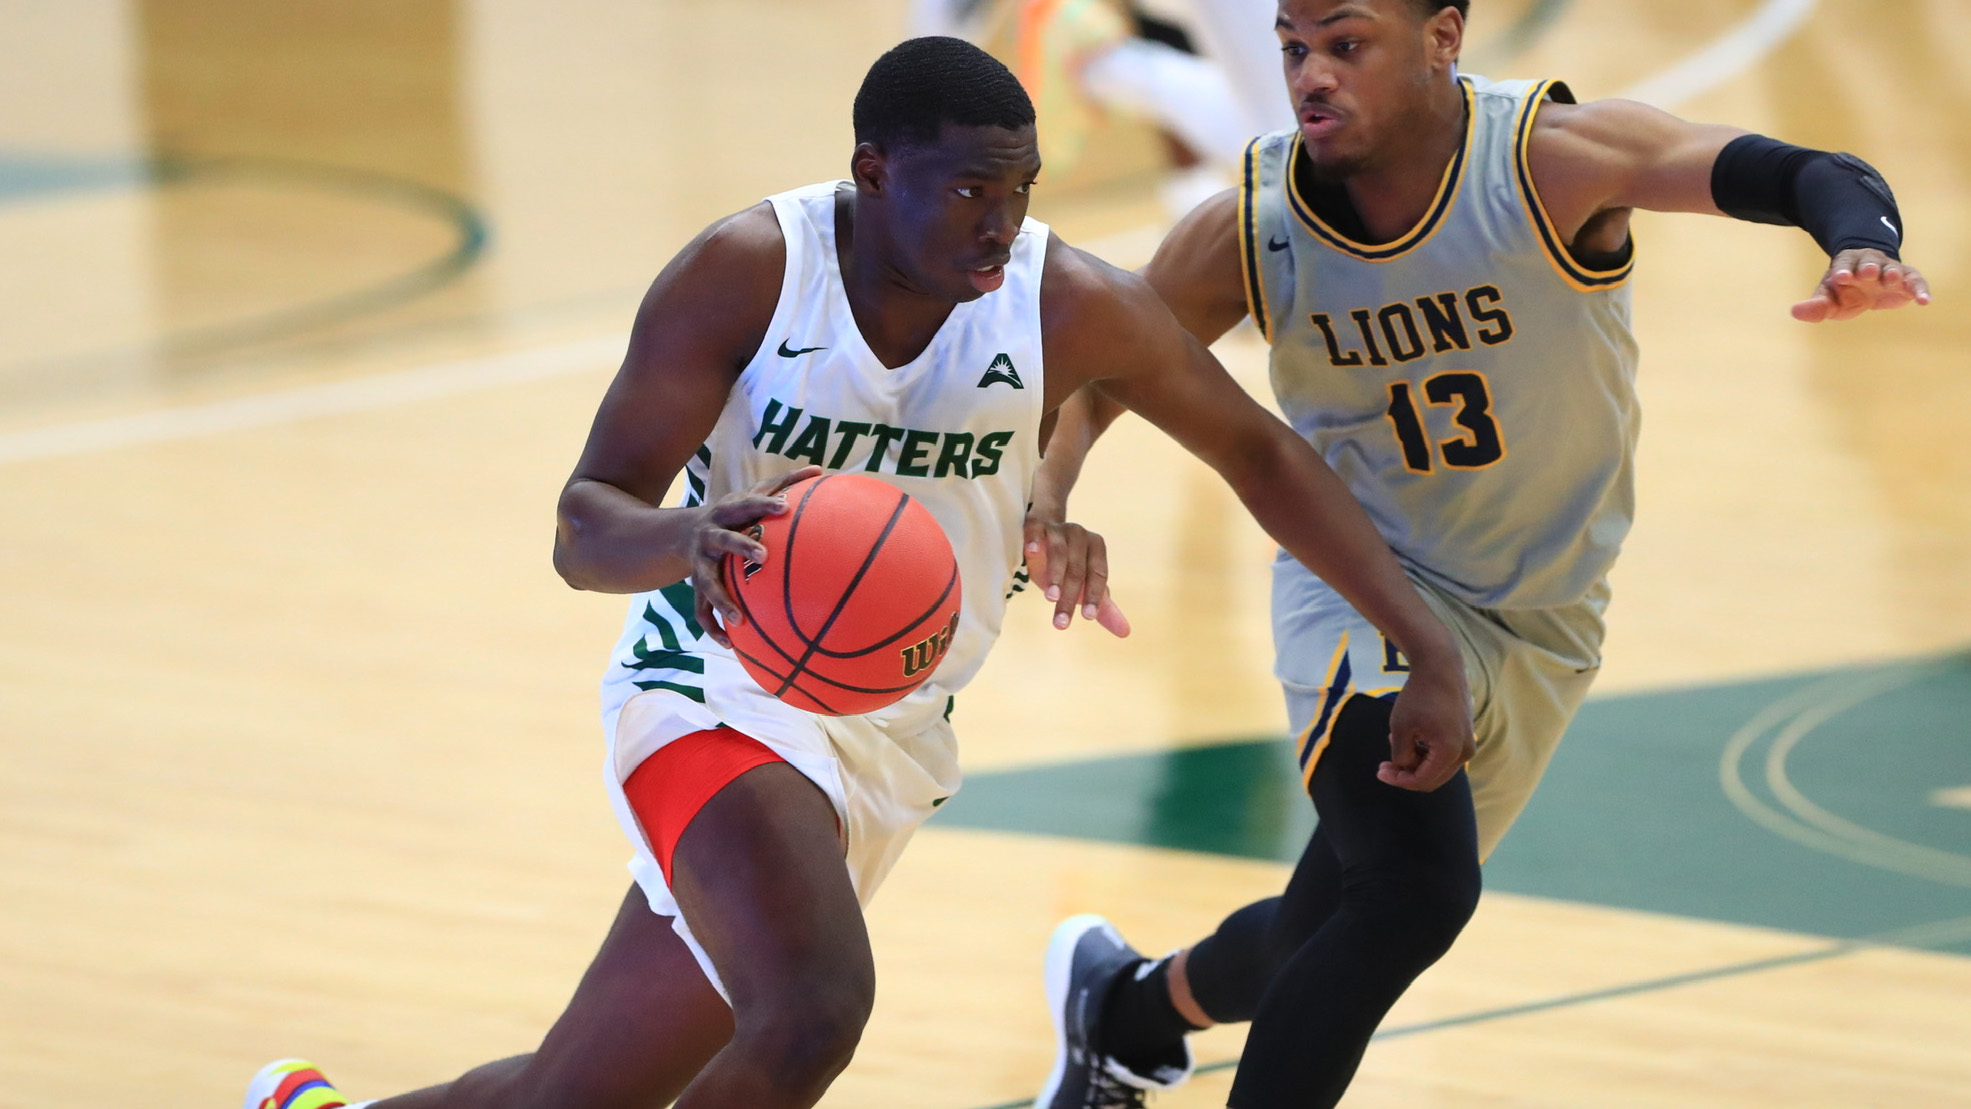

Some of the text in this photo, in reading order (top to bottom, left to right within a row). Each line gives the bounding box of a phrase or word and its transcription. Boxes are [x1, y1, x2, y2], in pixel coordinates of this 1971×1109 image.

[1311, 283, 1515, 367] LIONS
[753, 397, 1015, 480] HATTERS
[1386, 369, 1508, 475] 13
